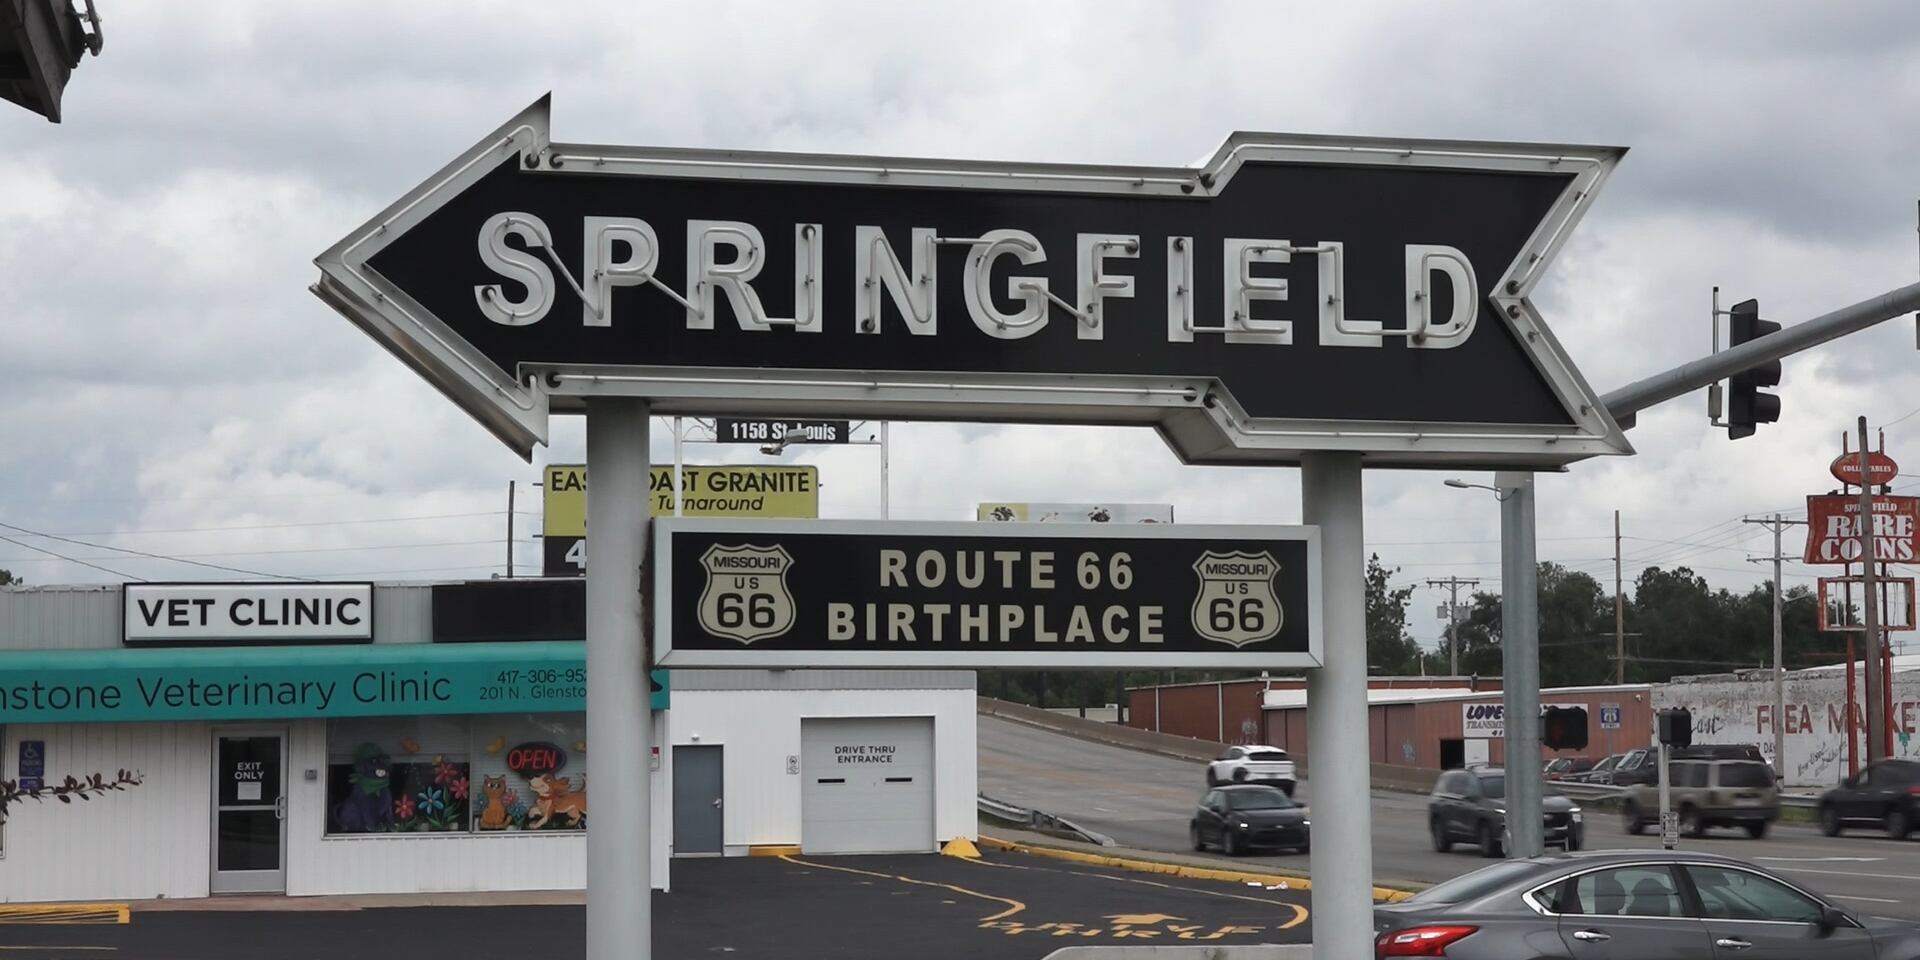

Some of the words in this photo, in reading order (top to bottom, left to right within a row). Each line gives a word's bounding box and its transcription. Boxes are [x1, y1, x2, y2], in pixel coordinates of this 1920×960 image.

[474, 211, 1479, 350] SPRINGFIELD
[731, 422, 767, 439] 1158
[707, 471, 809, 493] GRANITE
[658, 495, 764, 511] Tunaround
[1826, 514, 1914, 538] RARE
[713, 556, 780, 569] MISSOURI
[880, 549, 1055, 589] ROUTE
[1077, 551, 1133, 590] 66
[1205, 563, 1268, 576] MISSOURI
[138, 599, 215, 627] VET
[229, 597, 362, 626] CLINIC
[716, 592, 776, 629] 66
[1209, 597, 1265, 633] 66
[827, 602, 1164, 643] BIRTHPLACE
[497, 669, 587, 684] 417-306-95
[137, 674, 336, 711] Veterinary
[353, 670, 451, 703] Clinic
[480, 687, 502, 700] 201
[1466, 705, 1504, 720] LOVE
[835, 746, 865, 754] DRIVE
[868, 745, 896, 754] THRU
[237, 762, 262, 771] EXIT
[509, 749, 556, 770] OPEN
[838, 755, 893, 763] ENTRANCE
[234, 771, 264, 780] ONLY
